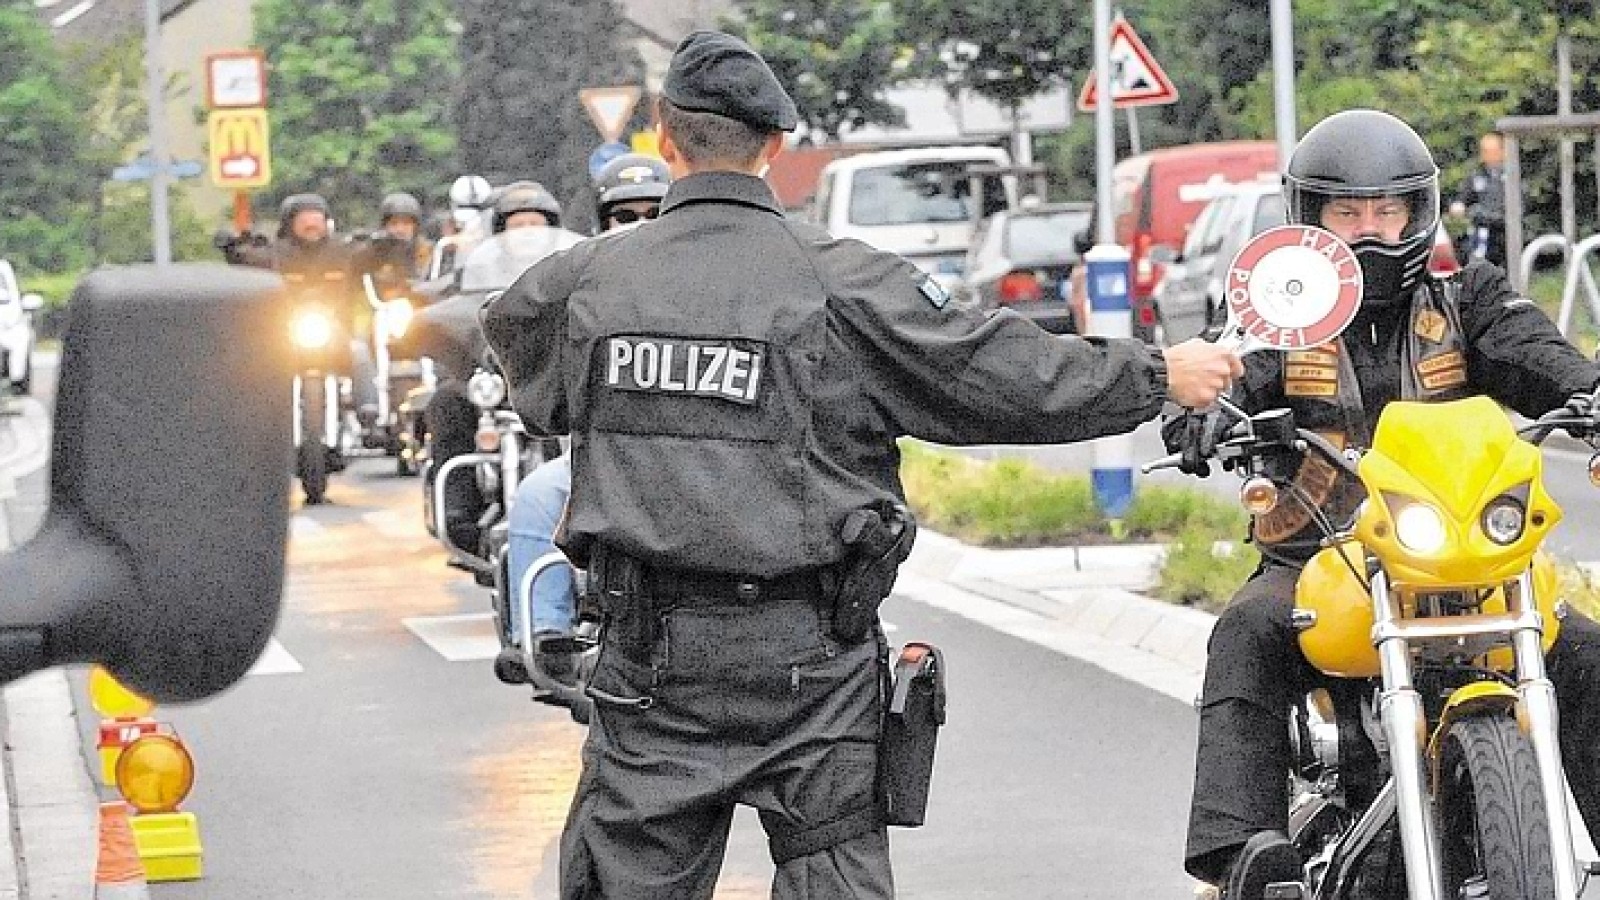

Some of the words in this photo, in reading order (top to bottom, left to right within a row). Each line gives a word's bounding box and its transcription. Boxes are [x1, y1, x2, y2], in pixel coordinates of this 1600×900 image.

[1301, 229, 1359, 287] HALT
[1230, 268, 1305, 347] POLIZEI
[608, 338, 761, 400] POLIZEI
